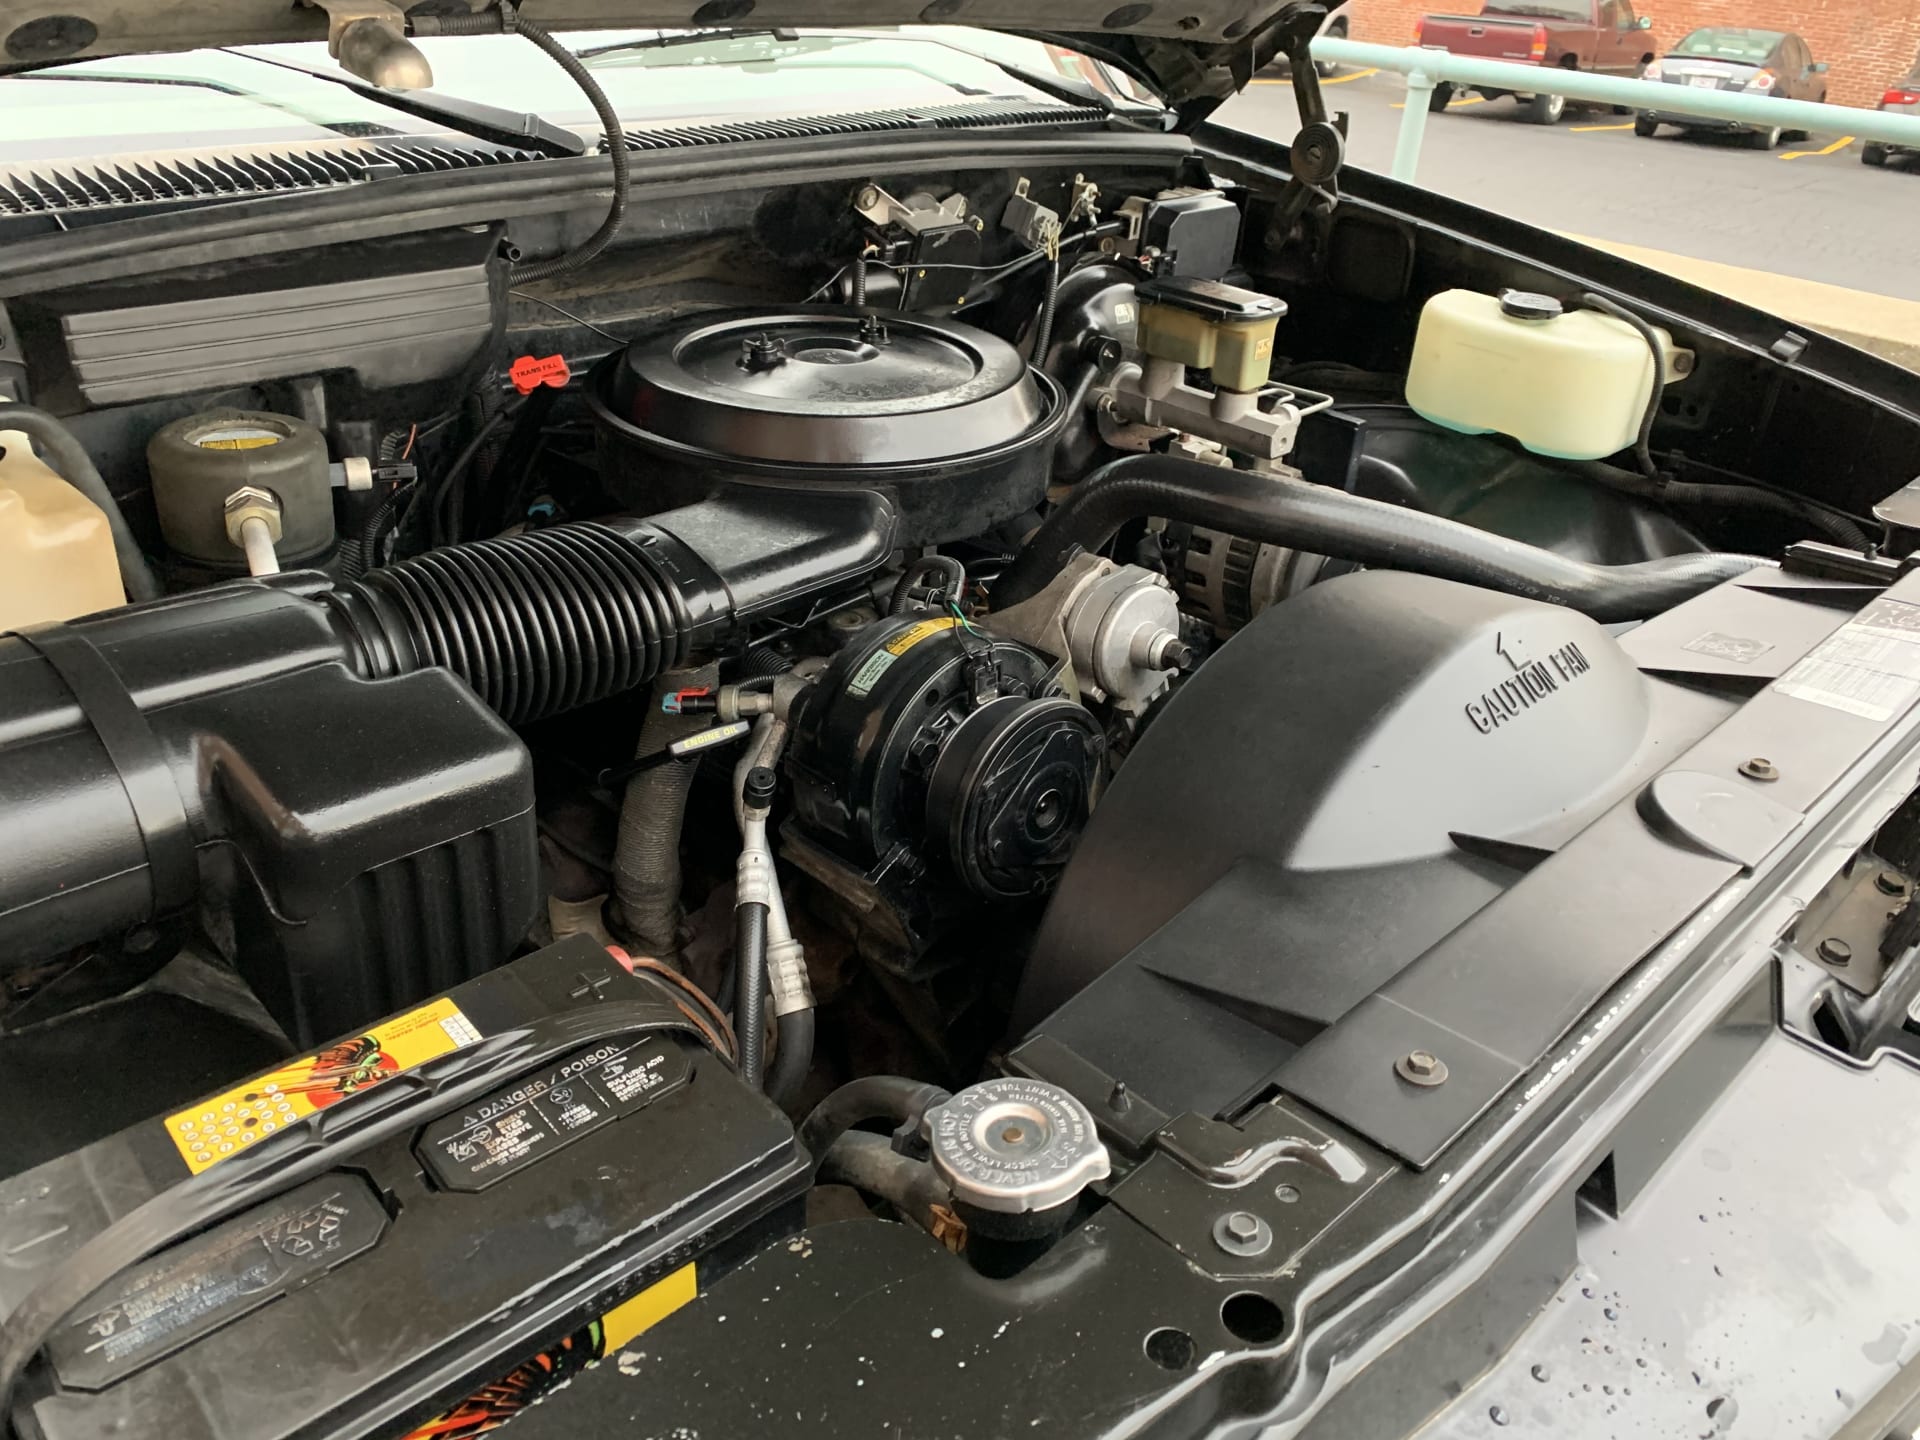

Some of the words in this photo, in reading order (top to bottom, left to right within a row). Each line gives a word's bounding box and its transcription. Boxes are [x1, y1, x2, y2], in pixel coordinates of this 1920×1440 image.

[1464, 660, 1559, 735] CAUTION
[1549, 641, 1590, 682] FAN
[683, 729, 720, 749] ENGINE
[723, 725, 740, 737] OIL
[646, 1055, 665, 1069] ACID
[478, 1080, 548, 1119] DANGER
[560, 1044, 620, 1078] POISON
[484, 1122, 533, 1150] EXPLOSIVE
[500, 1120, 524, 1135] EYES
[938, 1109, 959, 1137] HOT
[958, 1113, 973, 1141] BOTTLE
[977, 1166, 1041, 1185] NEVER
[1003, 1158, 1040, 1170] CHECK
